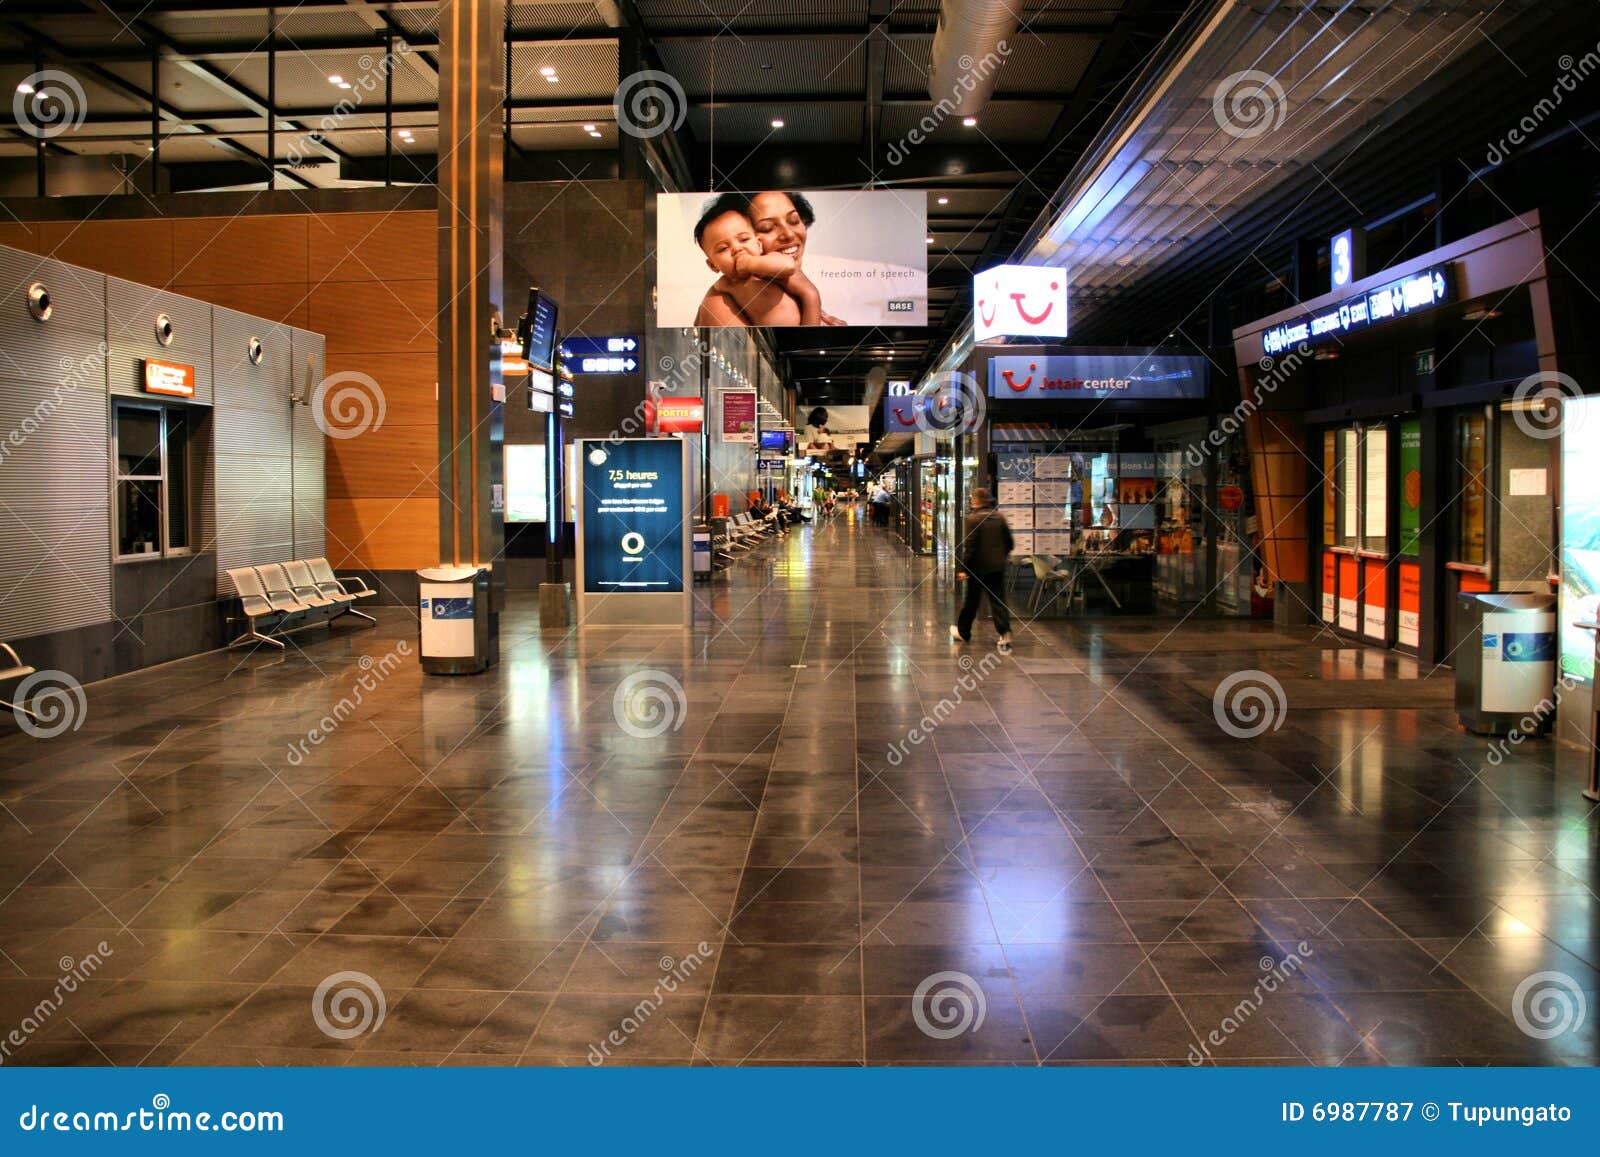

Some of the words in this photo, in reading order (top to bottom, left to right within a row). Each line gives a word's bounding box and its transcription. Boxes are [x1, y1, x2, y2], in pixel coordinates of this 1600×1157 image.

[1334, 237, 1350, 285] 3
[821, 269, 862, 278] freedom
[866, 269, 877, 278] of
[881, 269, 915, 280] speech
[889, 302, 913, 310] BASE
[1040, 377, 1131, 390] Jetaircenter
[608, 470, 624, 481] 7,5
[626, 470, 658, 480] heures
